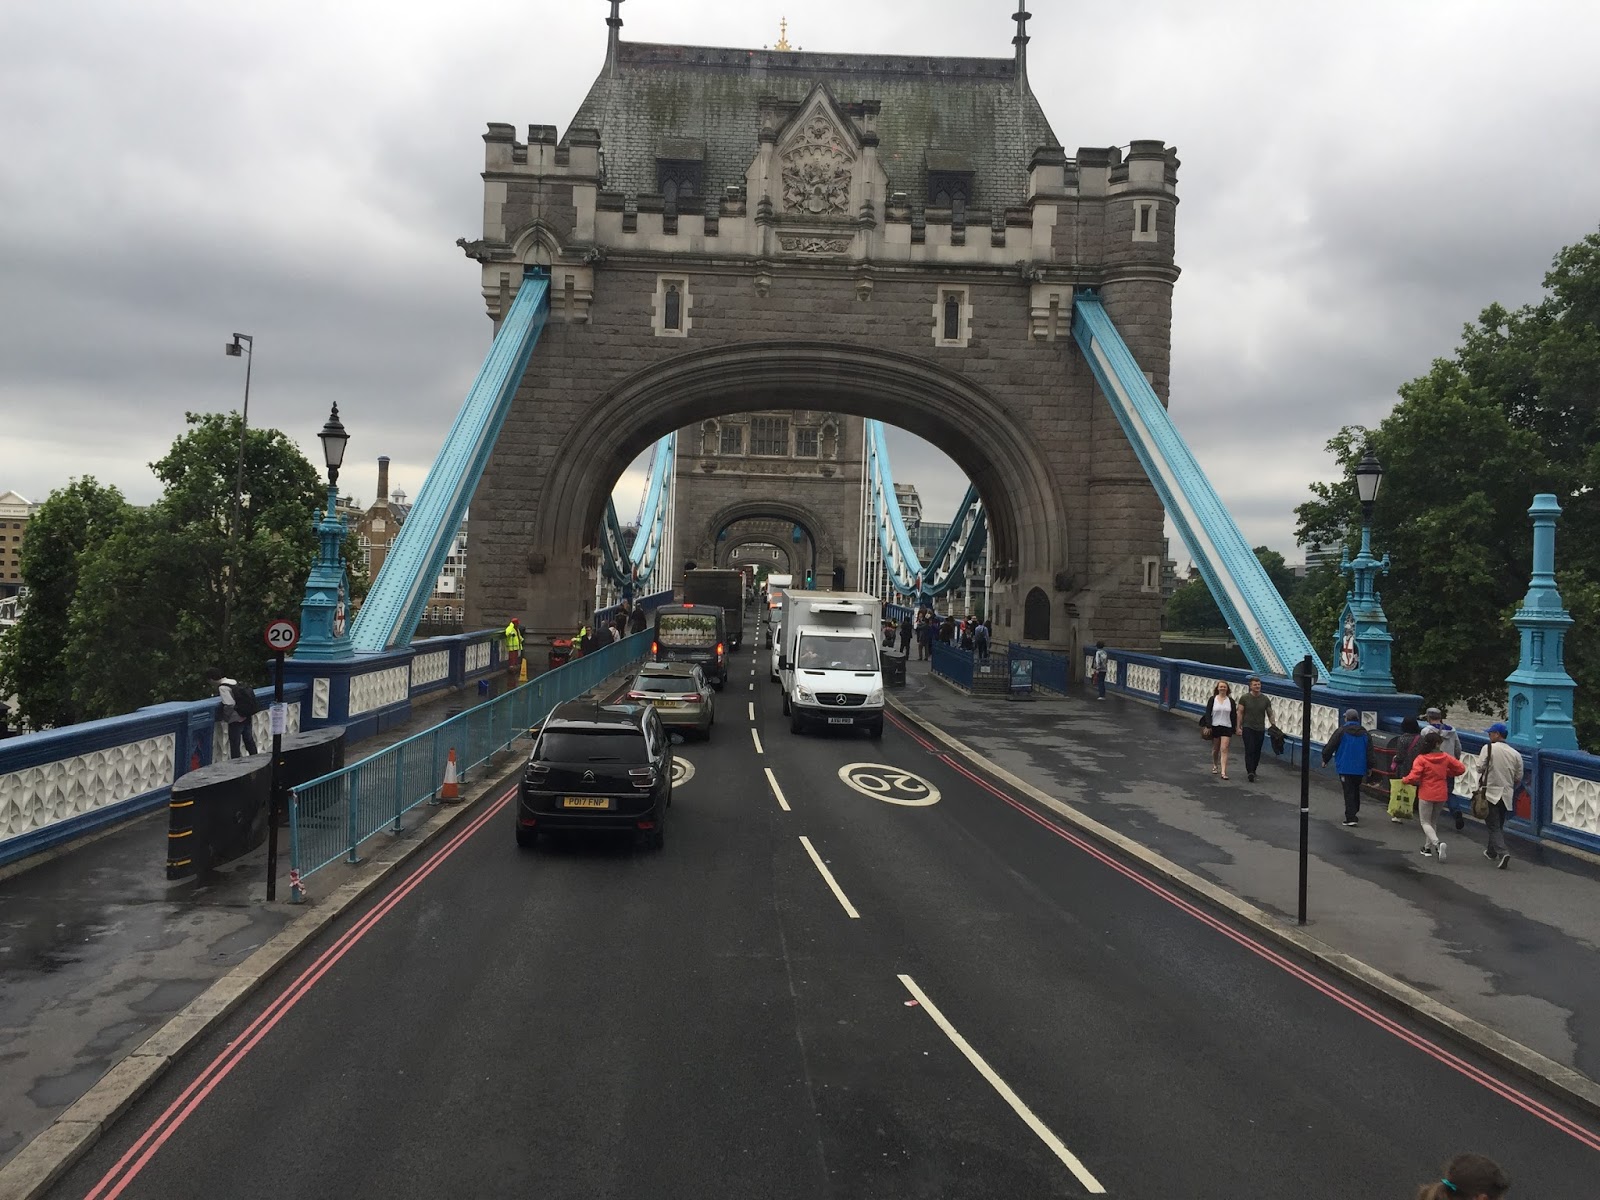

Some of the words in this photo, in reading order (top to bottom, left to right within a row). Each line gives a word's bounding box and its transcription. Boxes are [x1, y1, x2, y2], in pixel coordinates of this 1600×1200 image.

[270, 628, 293, 641] 20
[568, 797, 587, 806] PO17
[588, 798, 605, 806] FNP
